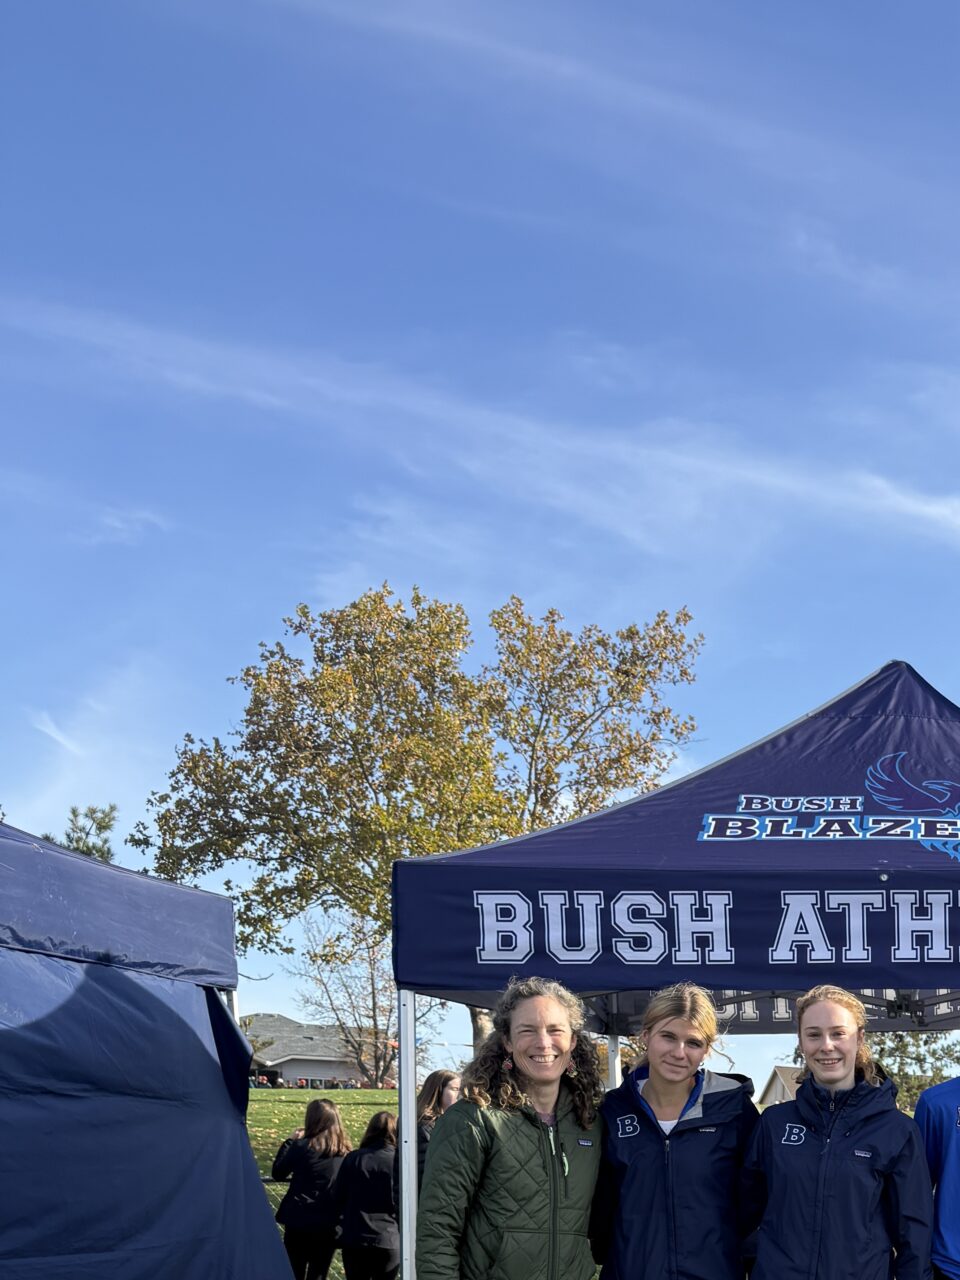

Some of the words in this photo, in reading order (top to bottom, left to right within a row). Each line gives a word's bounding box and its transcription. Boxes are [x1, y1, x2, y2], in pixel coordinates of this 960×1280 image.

[738, 794, 863, 812] BUSH
[473, 890, 735, 964] BUSH
[617, 1114, 640, 1137] B
[781, 1123, 806, 1145] B
